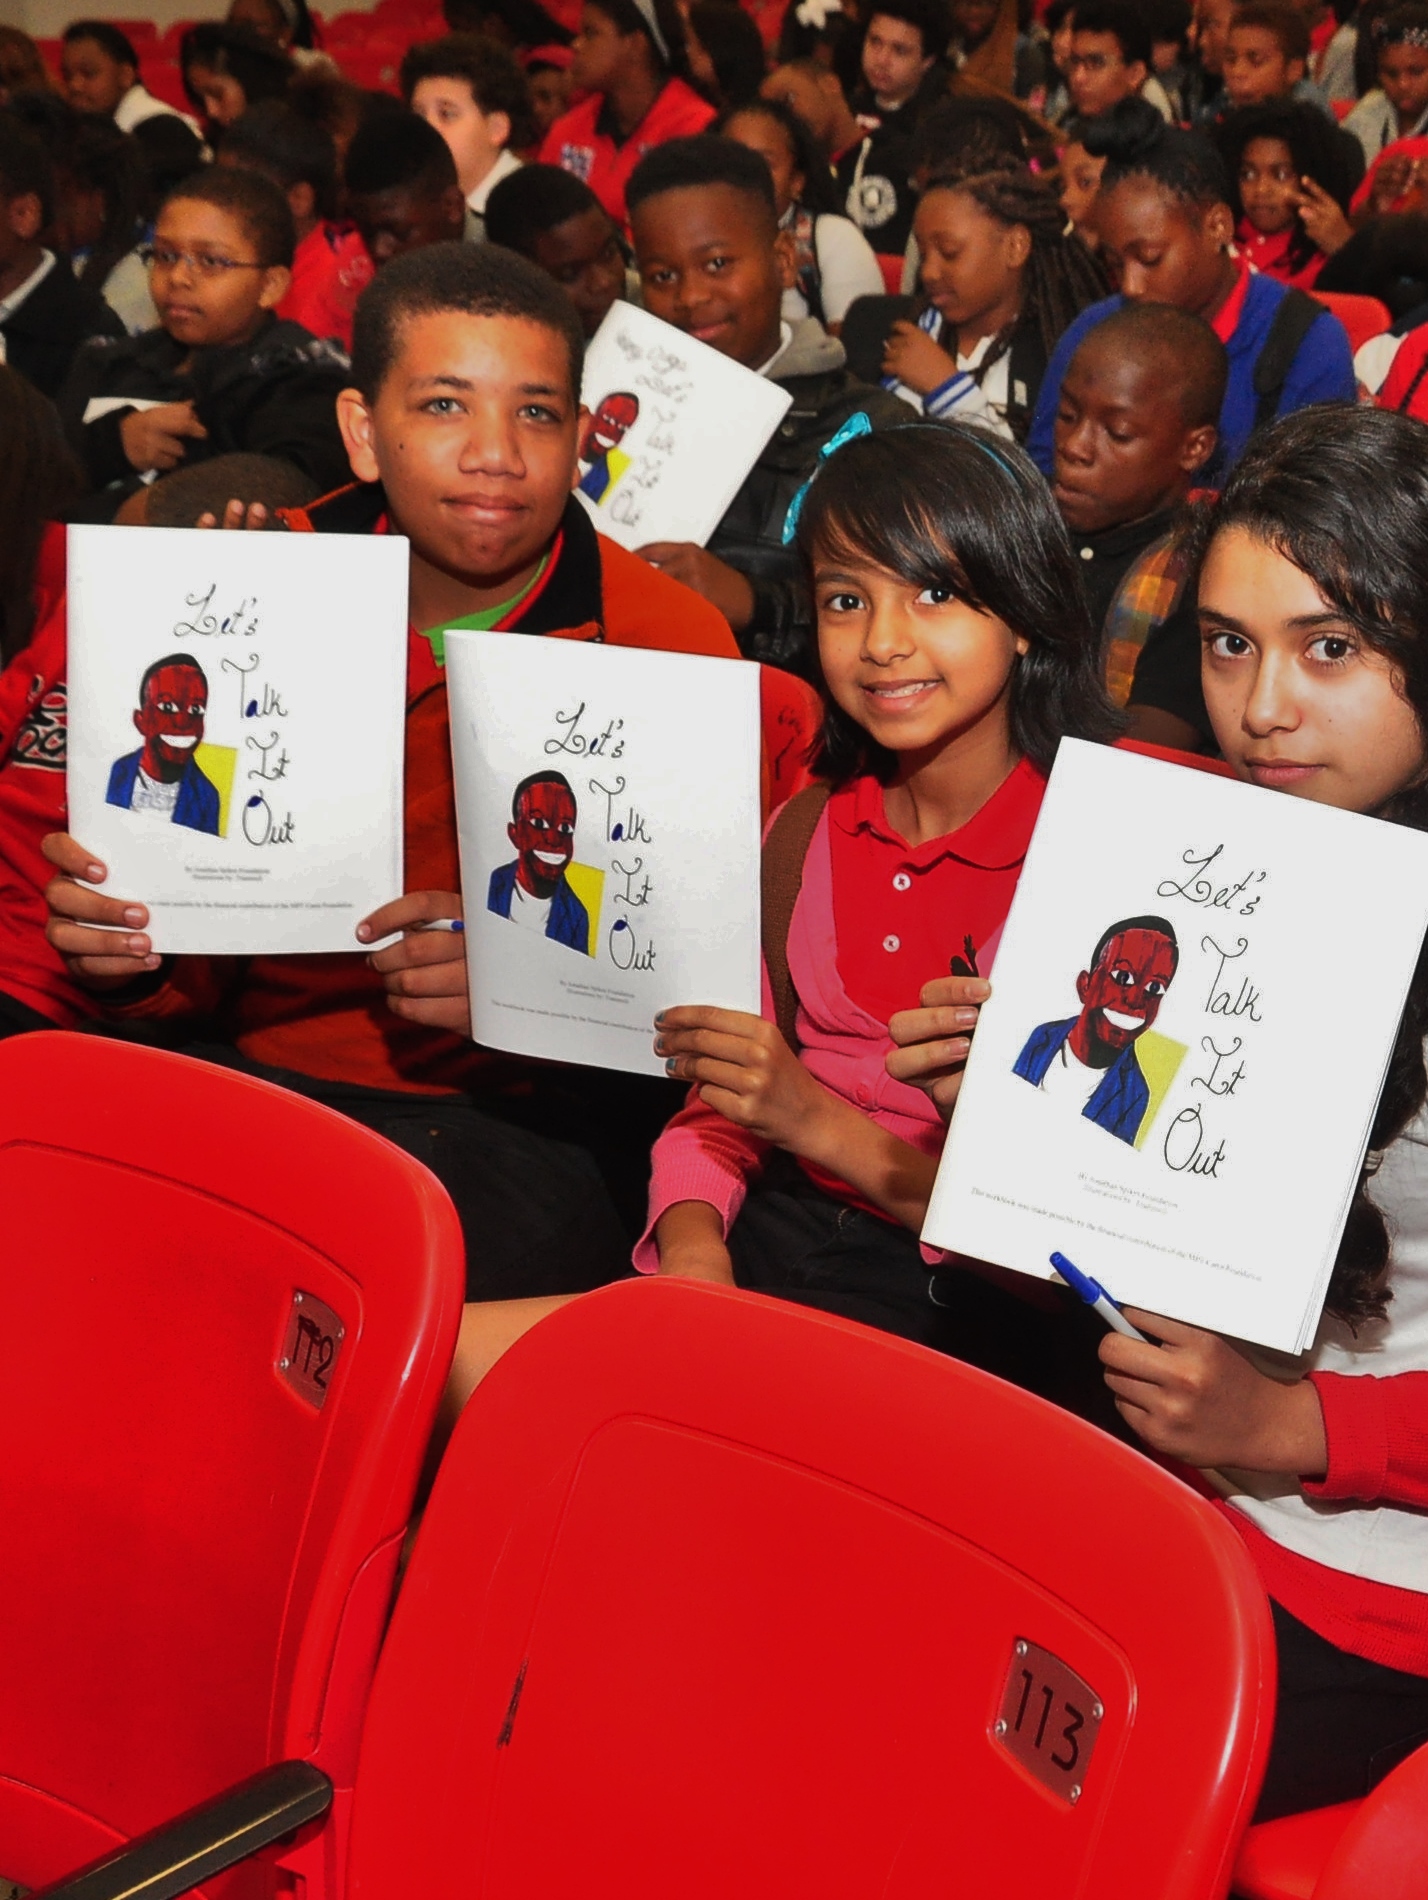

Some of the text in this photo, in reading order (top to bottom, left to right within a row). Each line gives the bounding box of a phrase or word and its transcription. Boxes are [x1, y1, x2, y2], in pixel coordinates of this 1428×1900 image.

[174, 583, 258, 637] Let's
[222, 653, 288, 719] Talk
[246, 731, 291, 781] It
[543, 701, 625, 759] Let's
[242, 789, 295, 847] Out
[588, 775, 653, 845] Talk
[611, 856, 654, 907] It
[1156, 842, 1269, 917] Let's
[608, 913, 657, 973] Out
[1200, 934, 1263, 1023] Talk
[1190, 1035, 1247, 1097] It
[1163, 1102, 1227, 1180] Out
[1013, 1668, 1086, 1773] 113
